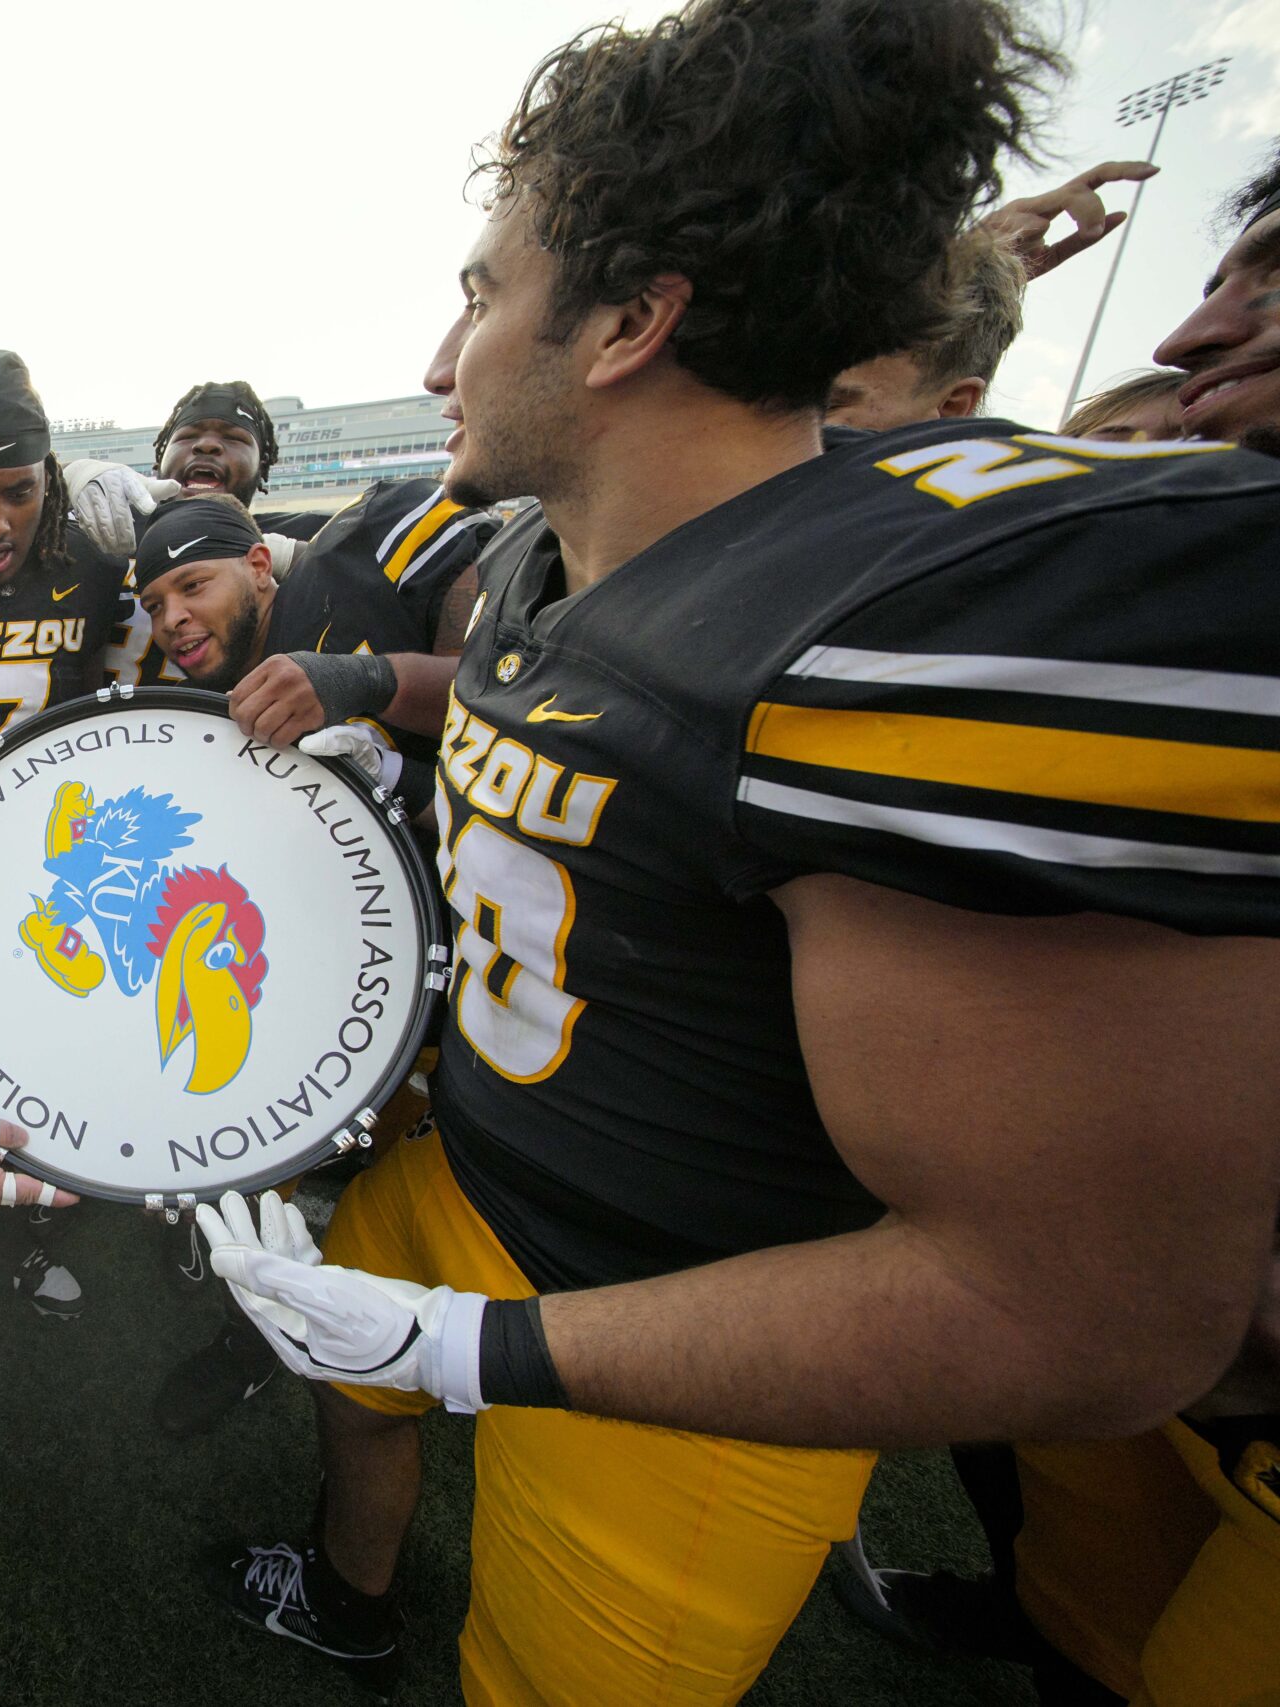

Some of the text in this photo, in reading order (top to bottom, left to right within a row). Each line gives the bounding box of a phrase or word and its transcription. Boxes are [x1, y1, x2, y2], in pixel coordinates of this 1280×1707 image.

[287, 428, 343, 444] TIGERS
[12, 723, 175, 790] STUDENT
[438, 679, 619, 847] ZZOU
[87, 852, 144, 927] KU
[167, 738, 394, 1173] KU ALUMNI ASSOCIATION
